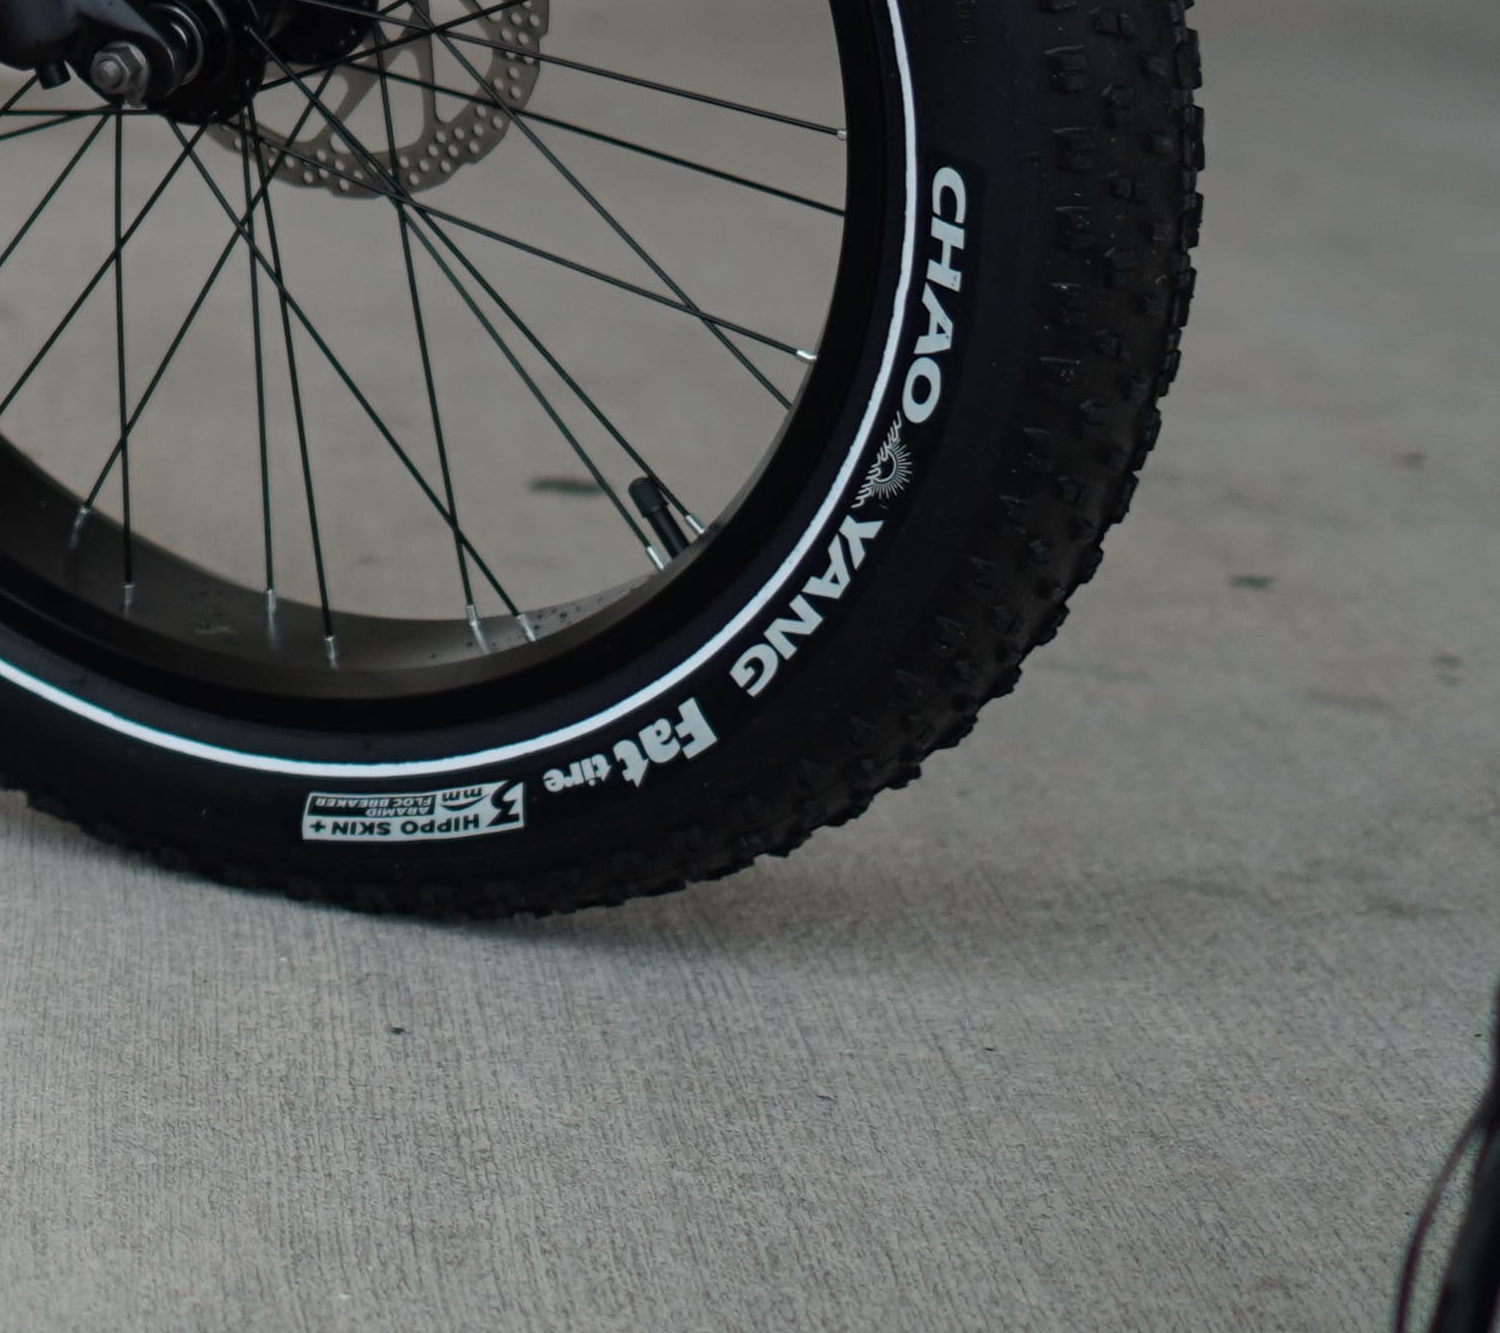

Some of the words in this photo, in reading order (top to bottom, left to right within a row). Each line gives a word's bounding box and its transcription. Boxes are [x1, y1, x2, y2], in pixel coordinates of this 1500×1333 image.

[902, 165, 967, 424] CHAO
[729, 514, 885, 698] YANG
[612, 696, 718, 788] Fat
[542, 752, 613, 793] tire
[314, 797, 390, 809] BREAKER
[365, 806, 430, 817] ARAMID
[391, 796, 432, 807] FLOC
[330, 820, 391, 836] SKIN
[400, 813, 480, 835] HIPPO
